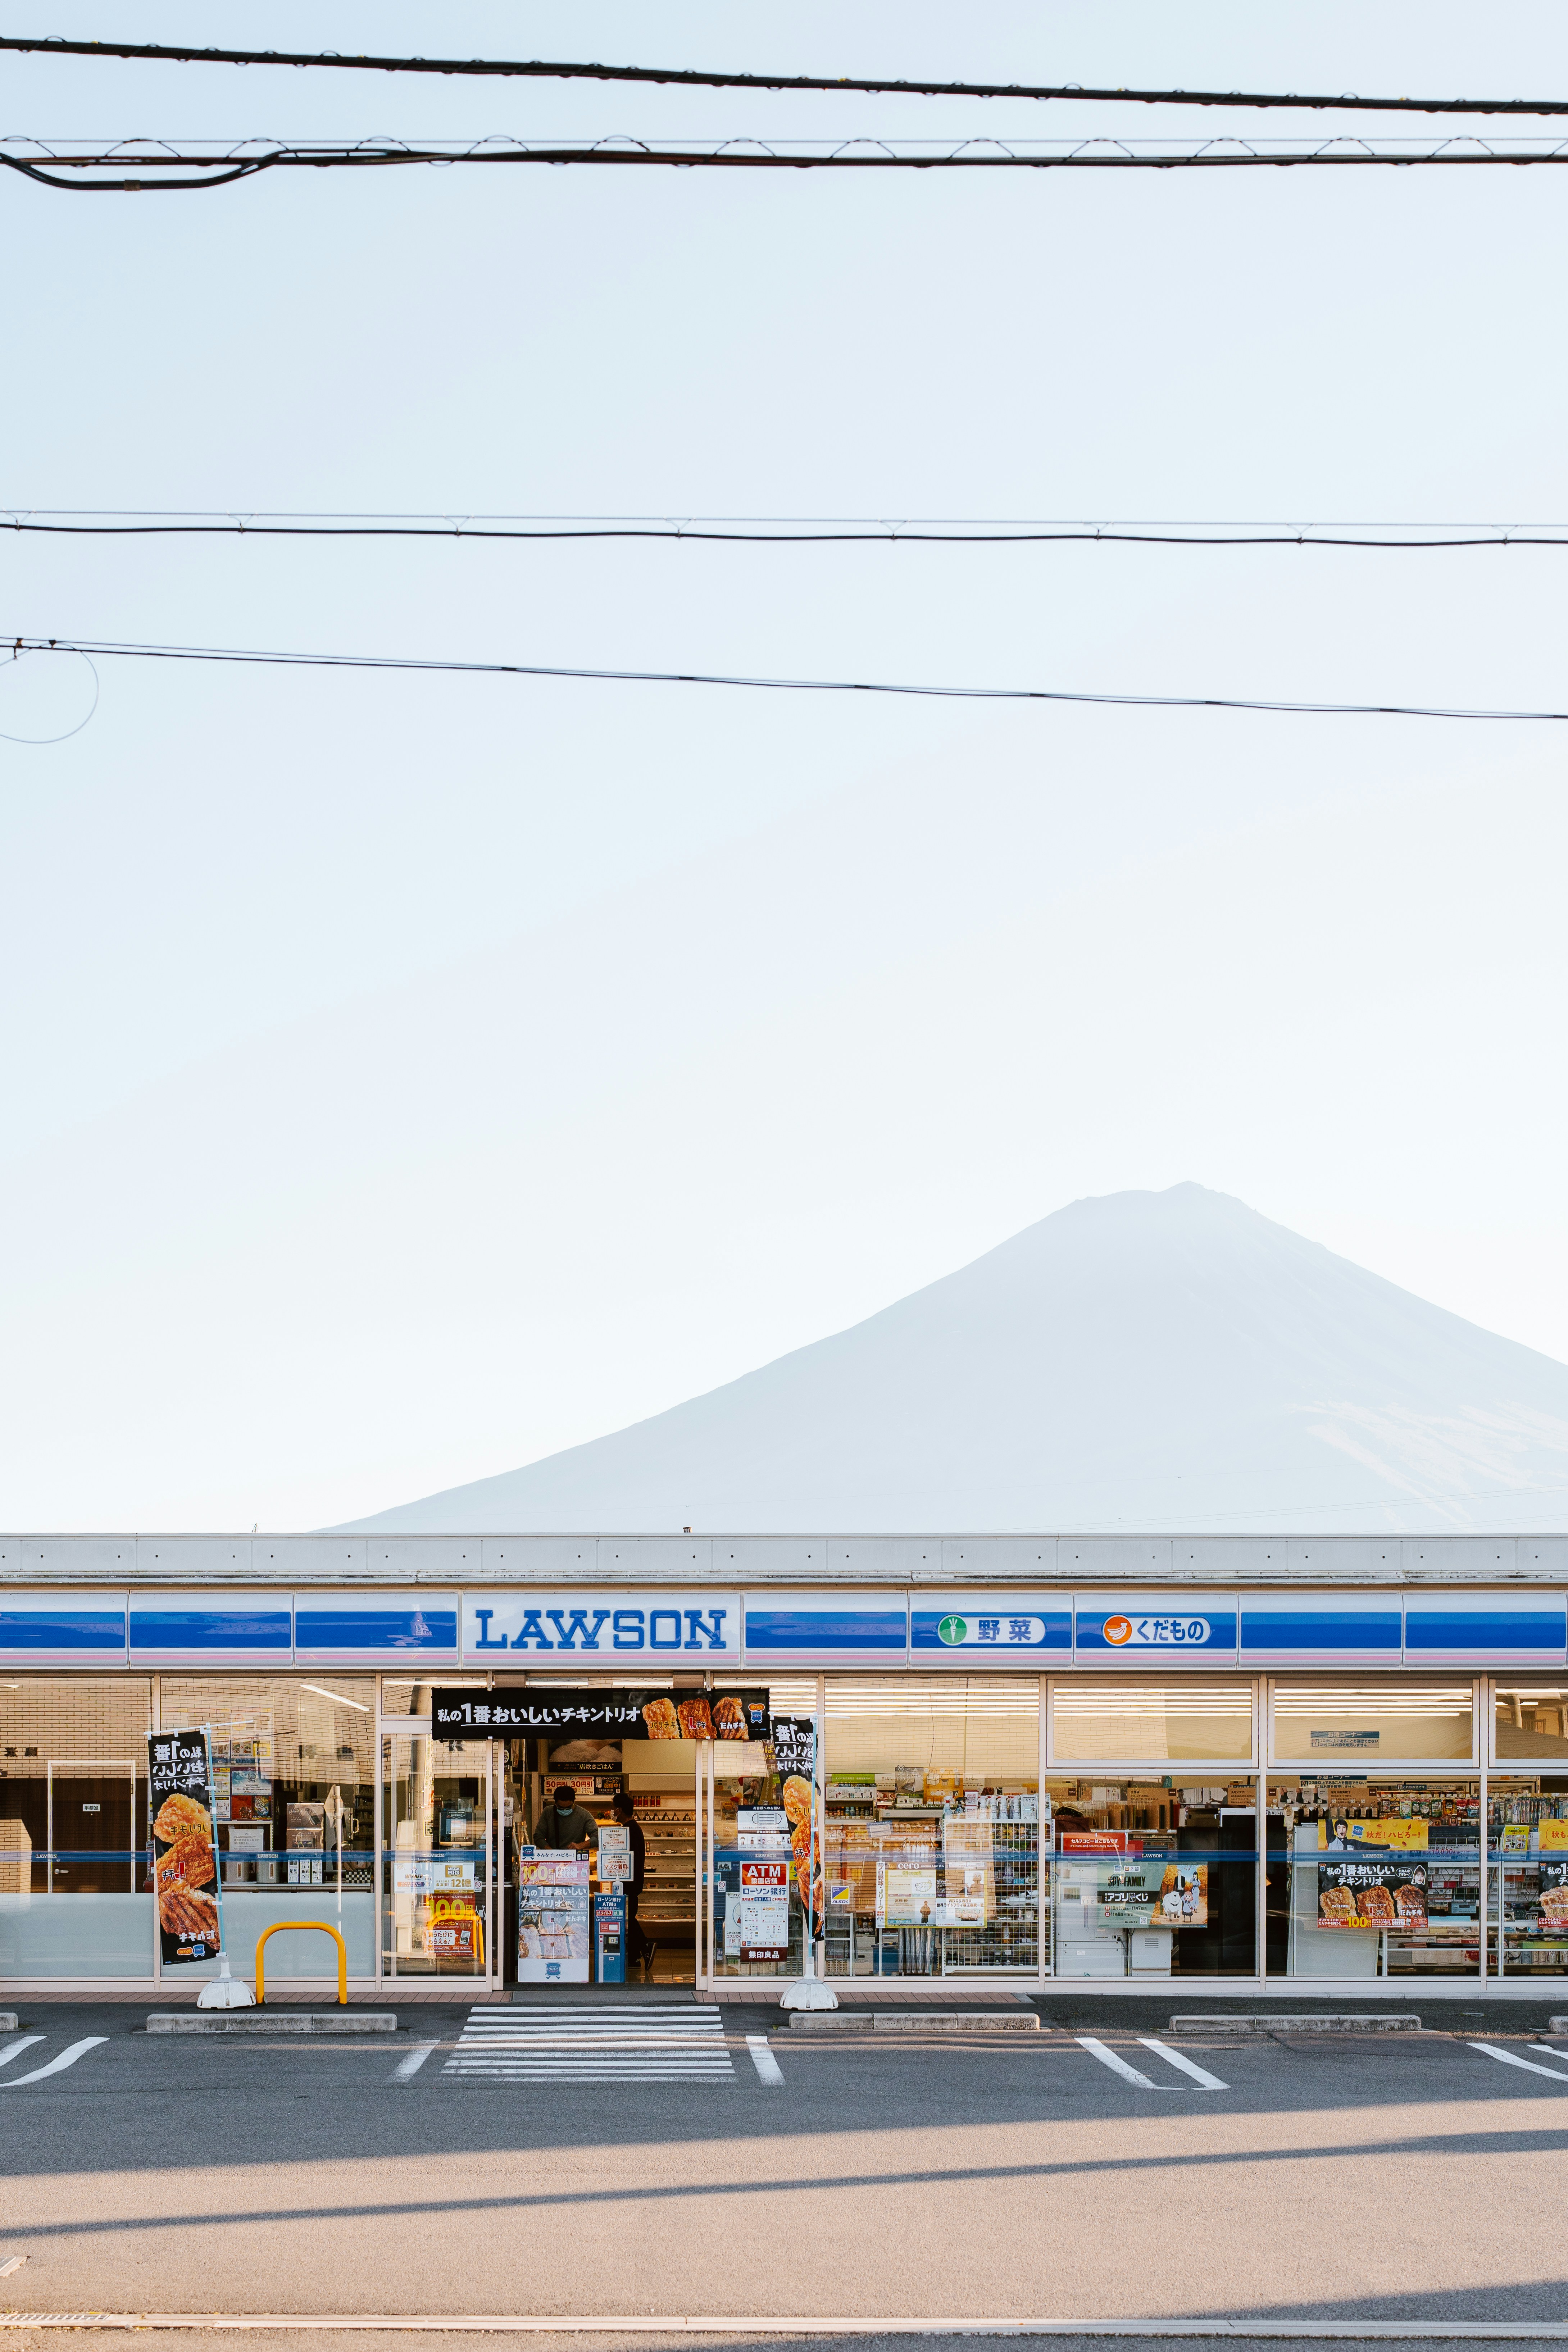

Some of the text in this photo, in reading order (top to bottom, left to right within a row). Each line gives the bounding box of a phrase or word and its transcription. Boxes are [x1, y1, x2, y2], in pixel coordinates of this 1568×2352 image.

[476, 1610, 727, 1649] LAWSON
[978, 1619, 1031, 1641] 野菜
[1137, 1619, 1204, 1641] くだもの
[437, 1703, 640, 1724] 私の1番おいしいチキントリオ
[747, 1744, 775, 1753] たんぱ
[747, 1865, 781, 1877] ATM
[1327, 1863, 1395, 1875] 私の1番おいしい
[1547, 1863, 1568, 1875] 私の1
[451, 1879, 471, 1887] 12億
[1338, 1877, 1383, 1886] チキントリオ
[1558, 1877, 1568, 1885] チ
[749, 1951, 780, 1959] 無印良品
